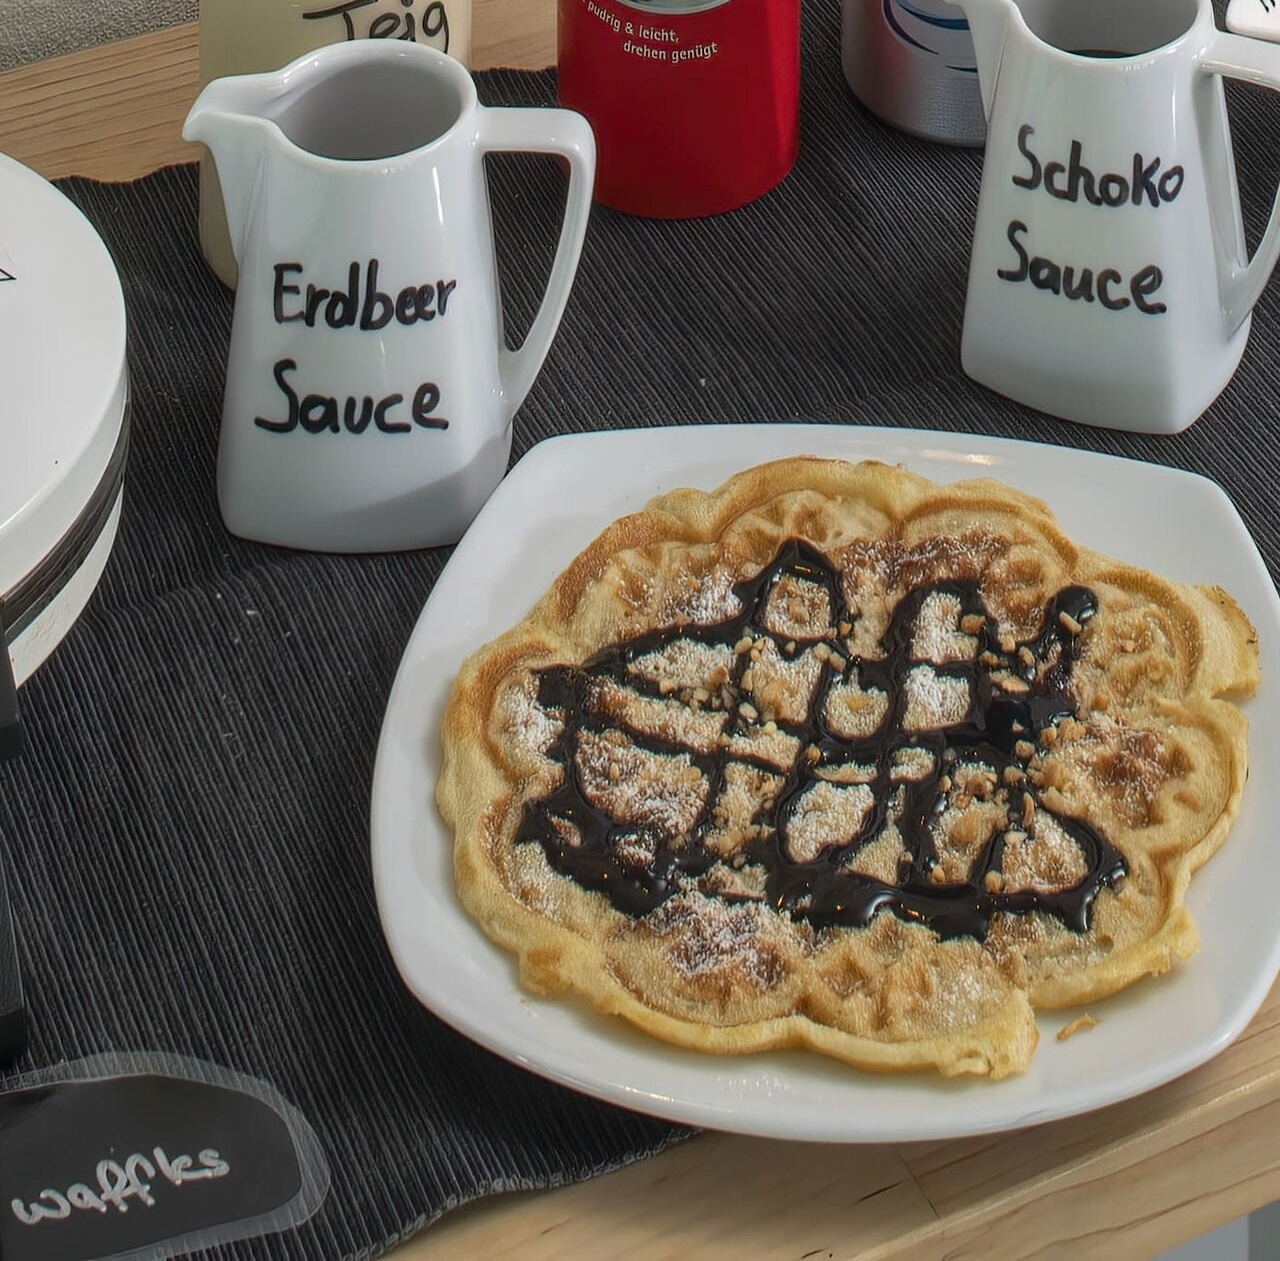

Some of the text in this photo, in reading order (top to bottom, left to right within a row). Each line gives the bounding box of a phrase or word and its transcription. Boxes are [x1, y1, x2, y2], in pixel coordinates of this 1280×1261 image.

[587, 1, 621, 32] pudrig
[624, 21, 634, 36] &
[638, 24, 681, 43] leicht,
[623, 40, 718, 64] drehen genügt
[1011, 122, 1186, 209] Schoko
[272, 257, 458, 332] Erdbeer
[996, 219, 1169, 316] Sauce
[253, 357, 450, 435] Sauce
